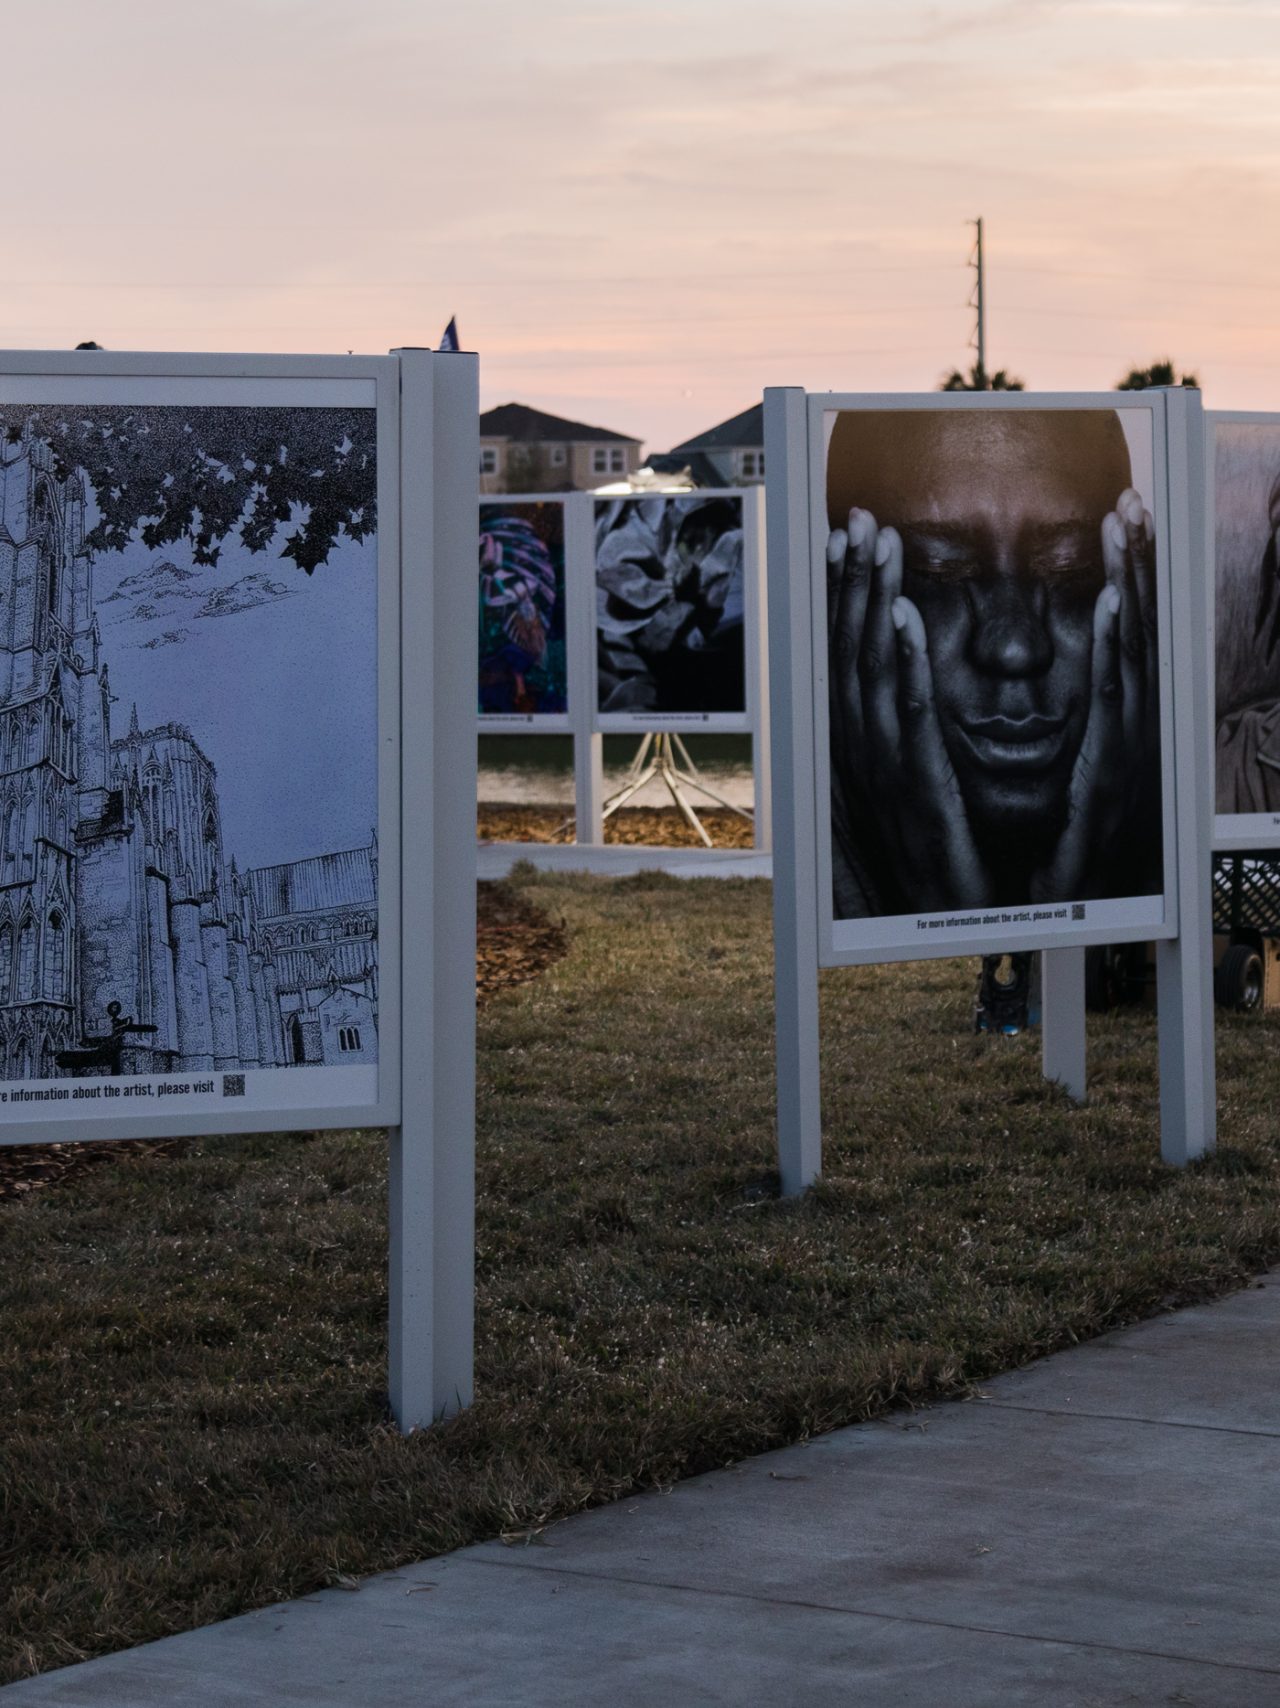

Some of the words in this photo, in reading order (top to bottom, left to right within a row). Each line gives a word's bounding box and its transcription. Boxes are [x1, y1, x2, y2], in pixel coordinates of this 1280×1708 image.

[917, 919, 927, 929] For
[928, 920, 945, 929] more
[946, 917, 982, 928] information
[982, 914, 1000, 924] about
[1001, 912, 1012, 923] the
[1013, 911, 1032, 922] artist,
[1033, 909, 1053, 922] please
[1054, 908, 1067, 919] visit
[11, 1087, 69, 1102] information
[73, 1085, 101, 1099] about
[104, 1084, 120, 1097] the
[123, 1082, 155, 1097] artist,
[157, 1082, 190, 1098] please
[193, 1080, 215, 1093] visit
